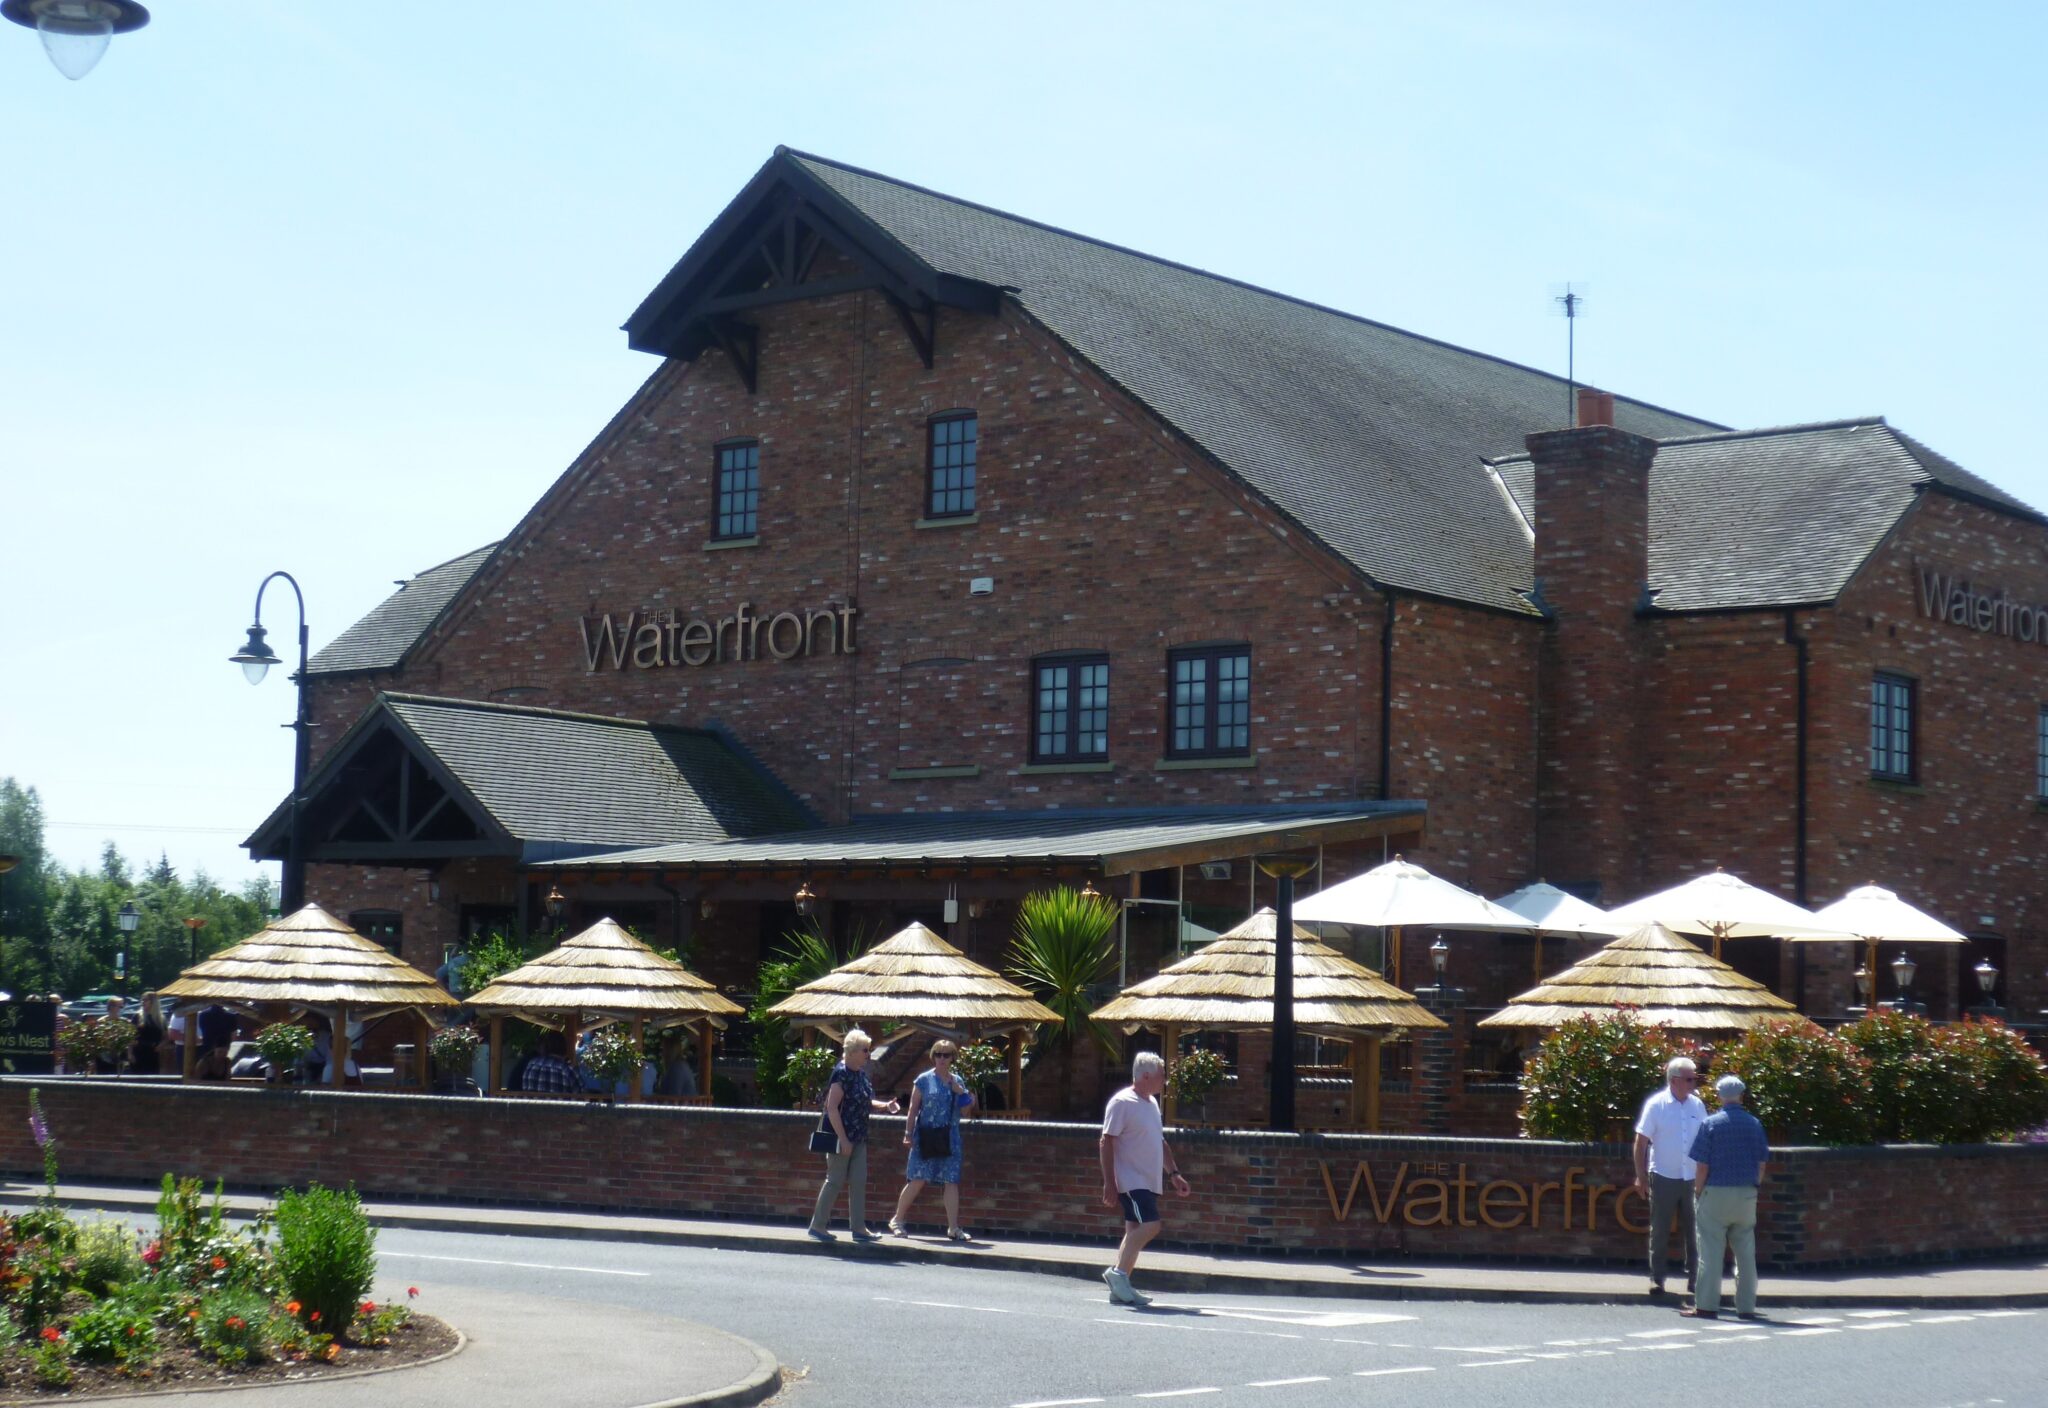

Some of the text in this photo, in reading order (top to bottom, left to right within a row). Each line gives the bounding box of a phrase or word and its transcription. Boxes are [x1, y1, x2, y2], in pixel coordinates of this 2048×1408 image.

[641, 609, 665, 624] THE
[579, 602, 857, 672] Waterfront
[19, 1033, 50, 1048] Nest
[1412, 1161, 1449, 1176] THE
[1319, 1160, 1678, 1233] Waterfro
